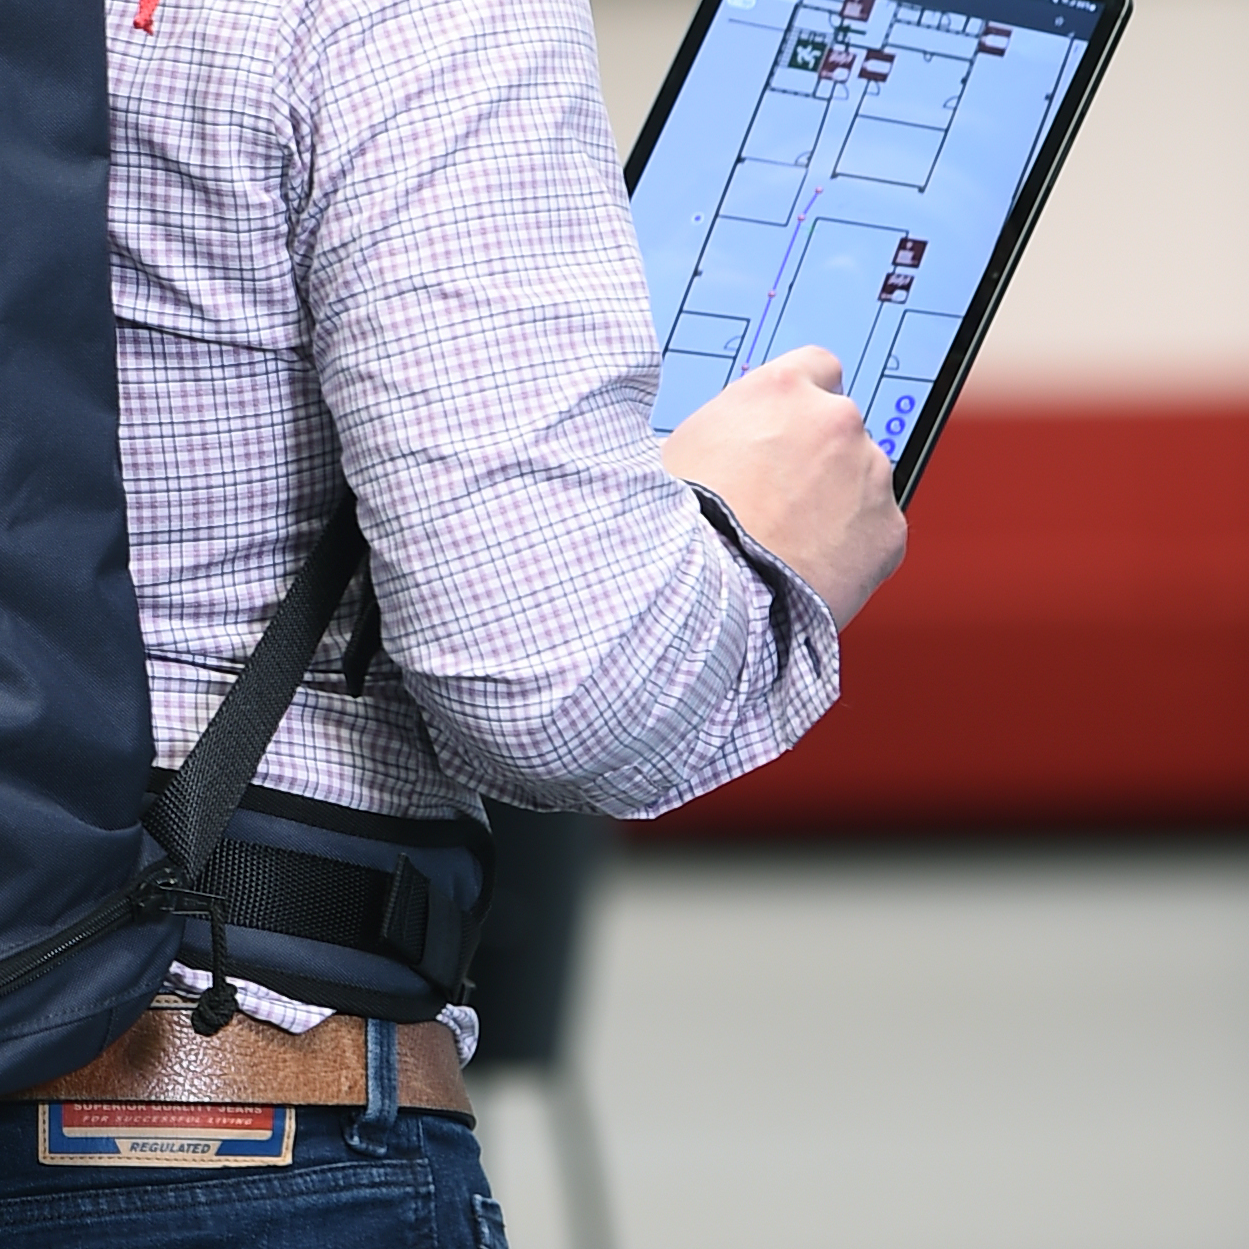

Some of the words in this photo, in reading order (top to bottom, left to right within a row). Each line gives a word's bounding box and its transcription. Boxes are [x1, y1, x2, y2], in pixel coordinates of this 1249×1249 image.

[82, 1115, 110, 1123] FOR
[115, 1115, 201, 1124] SUCCESSFUL
[207, 1117, 253, 1126] LIVING
[129, 1141, 212, 1154] REGULATED
